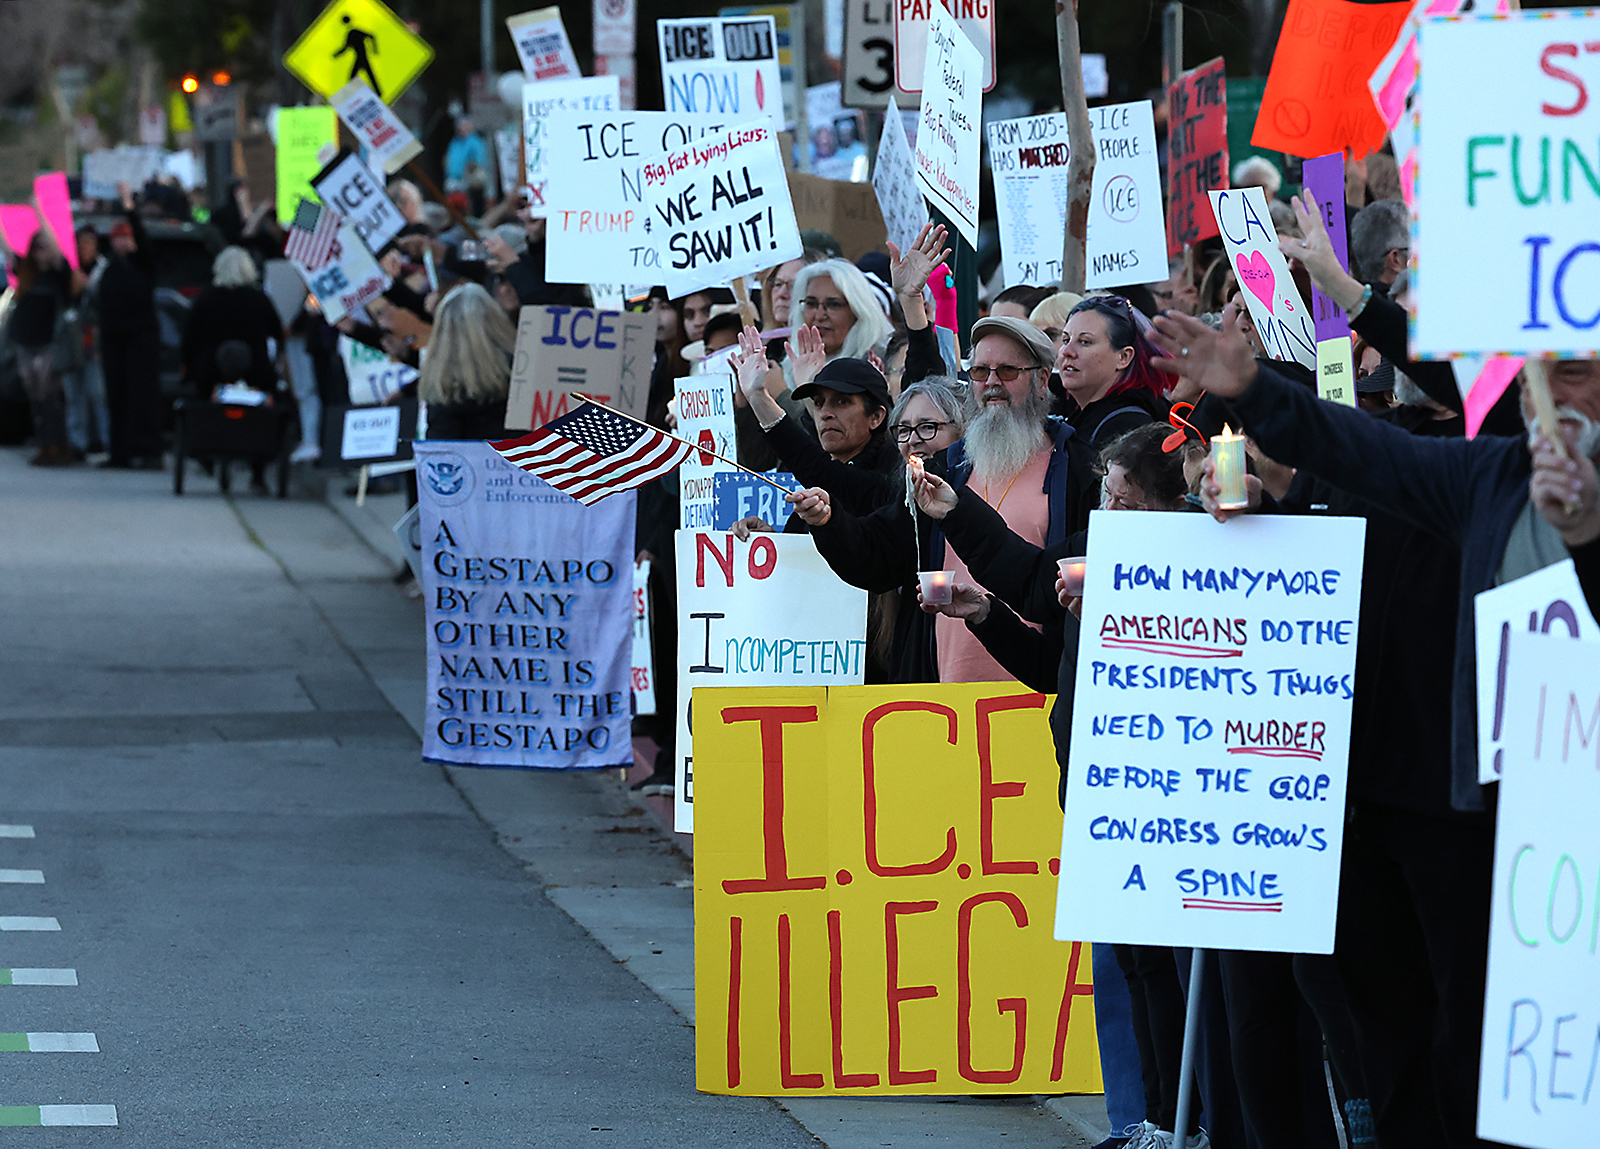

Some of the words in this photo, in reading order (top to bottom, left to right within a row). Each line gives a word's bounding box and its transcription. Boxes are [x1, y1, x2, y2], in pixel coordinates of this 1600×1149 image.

[900, 0, 988, 21] PAING
[673, 26, 709, 58] ICE
[724, 22, 772, 60] OUT
[669, 72, 739, 114] NOW
[942, 60, 965, 99] Federal
[948, 98, 966, 130] Taxes
[989, 122, 1022, 145] FROM
[1100, 108, 1129, 131] ICE
[577, 121, 639, 161] ICE
[692, 142, 728, 168] Lying
[992, 150, 1015, 171] HAS
[1100, 137, 1140, 160] PEOPLE
[332, 173, 374, 216] ICE
[655, 183, 702, 227] WE
[711, 166, 764, 211] ALL
[1109, 187, 1136, 214] ICE
[354, 201, 390, 237] OUT
[557, 209, 635, 233] TRUMP
[1218, 191, 1271, 245] CA
[669, 225, 732, 269] SAW
[738, 206, 777, 253] IT!
[1017, 261, 1039, 283] SAY
[1093, 250, 1140, 276] NAMES
[541, 306, 620, 349] ICE
[1257, 316, 1316, 362] MN
[680, 389, 711, 420] CRUSH
[711, 388, 726, 415] ICE
[485, 474, 513, 486] and
[737, 485, 806, 526] FRE
[433, 519, 458, 548] A
[433, 550, 614, 585] GESTAPO
[695, 532, 778, 588] NO
[1113, 563, 1171, 590] HOW
[1182, 567, 1264, 598] MANY
[1266, 569, 1341, 597] MORE
[435, 586, 478, 613] BY
[494, 590, 575, 617] ANY
[433, 620, 568, 650] OTHER
[1099, 614, 1247, 646] AMERICANS
[1261, 619, 1293, 642] DO
[1296, 620, 1354, 645] THE
[440, 654, 549, 682] NAME
[563, 660, 593, 684] IS
[1091, 661, 1258, 696] PRESIDENTS
[1267, 668, 1354, 700] THUGS
[436, 687, 541, 716] STILL
[553, 691, 623, 718] THE
[437, 717, 610, 751] GESTAPO
[1092, 713, 1165, 741] NEED
[1175, 715, 1213, 745] TO
[1224, 720, 1326, 751] MURDER
[1086, 764, 1181, 797] BEFORE
[1196, 768, 1252, 793] THE
[1090, 816, 1220, 845] CONGRESS
[1233, 822, 1327, 851] GROWS
[1123, 864, 1146, 890] A
[1175, 868, 1283, 899] SPINE
[1508, 843, 1600, 954] CO
[1504, 998, 1600, 1115] RE
